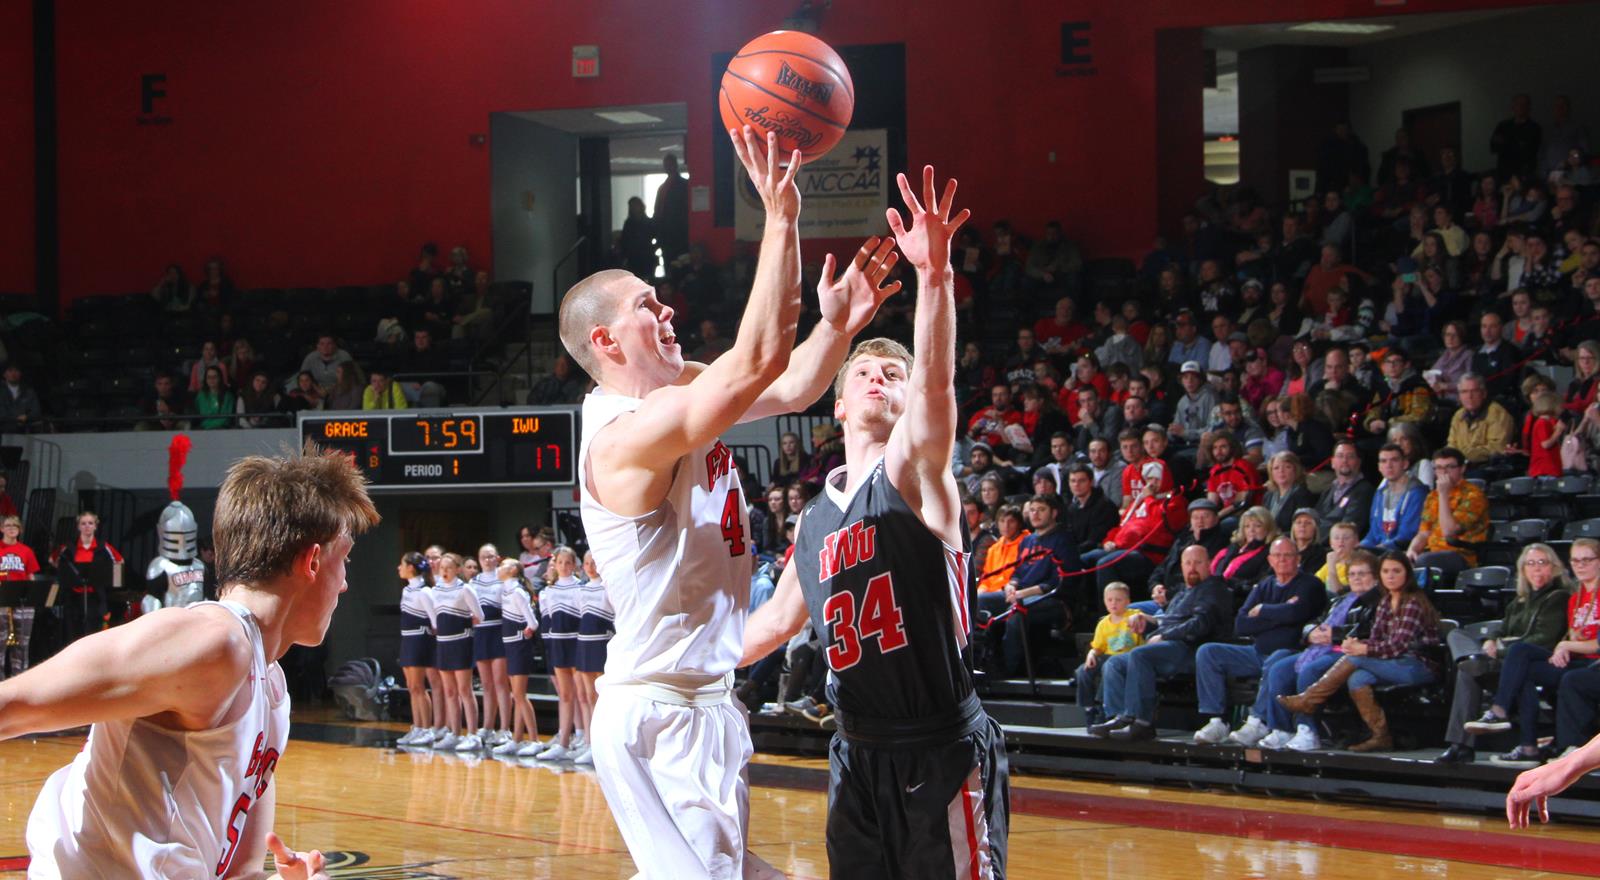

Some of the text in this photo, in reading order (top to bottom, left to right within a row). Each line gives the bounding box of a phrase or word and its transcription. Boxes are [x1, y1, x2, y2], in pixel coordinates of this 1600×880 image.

[1062, 22, 1092, 64] E
[142, 74, 167, 113] F
[805, 171, 881, 192] NCCAA
[324, 421, 369, 438] GRACE
[416, 419, 478, 448] 7:59
[512, 417, 540, 434] IWU
[404, 457, 460, 477] PERIOD 1
[536, 444, 561, 470] 17
[720, 488, 746, 557] 4
[819, 519, 877, 583] IWU
[823, 571, 909, 672] 34
[215, 792, 251, 877] 5
